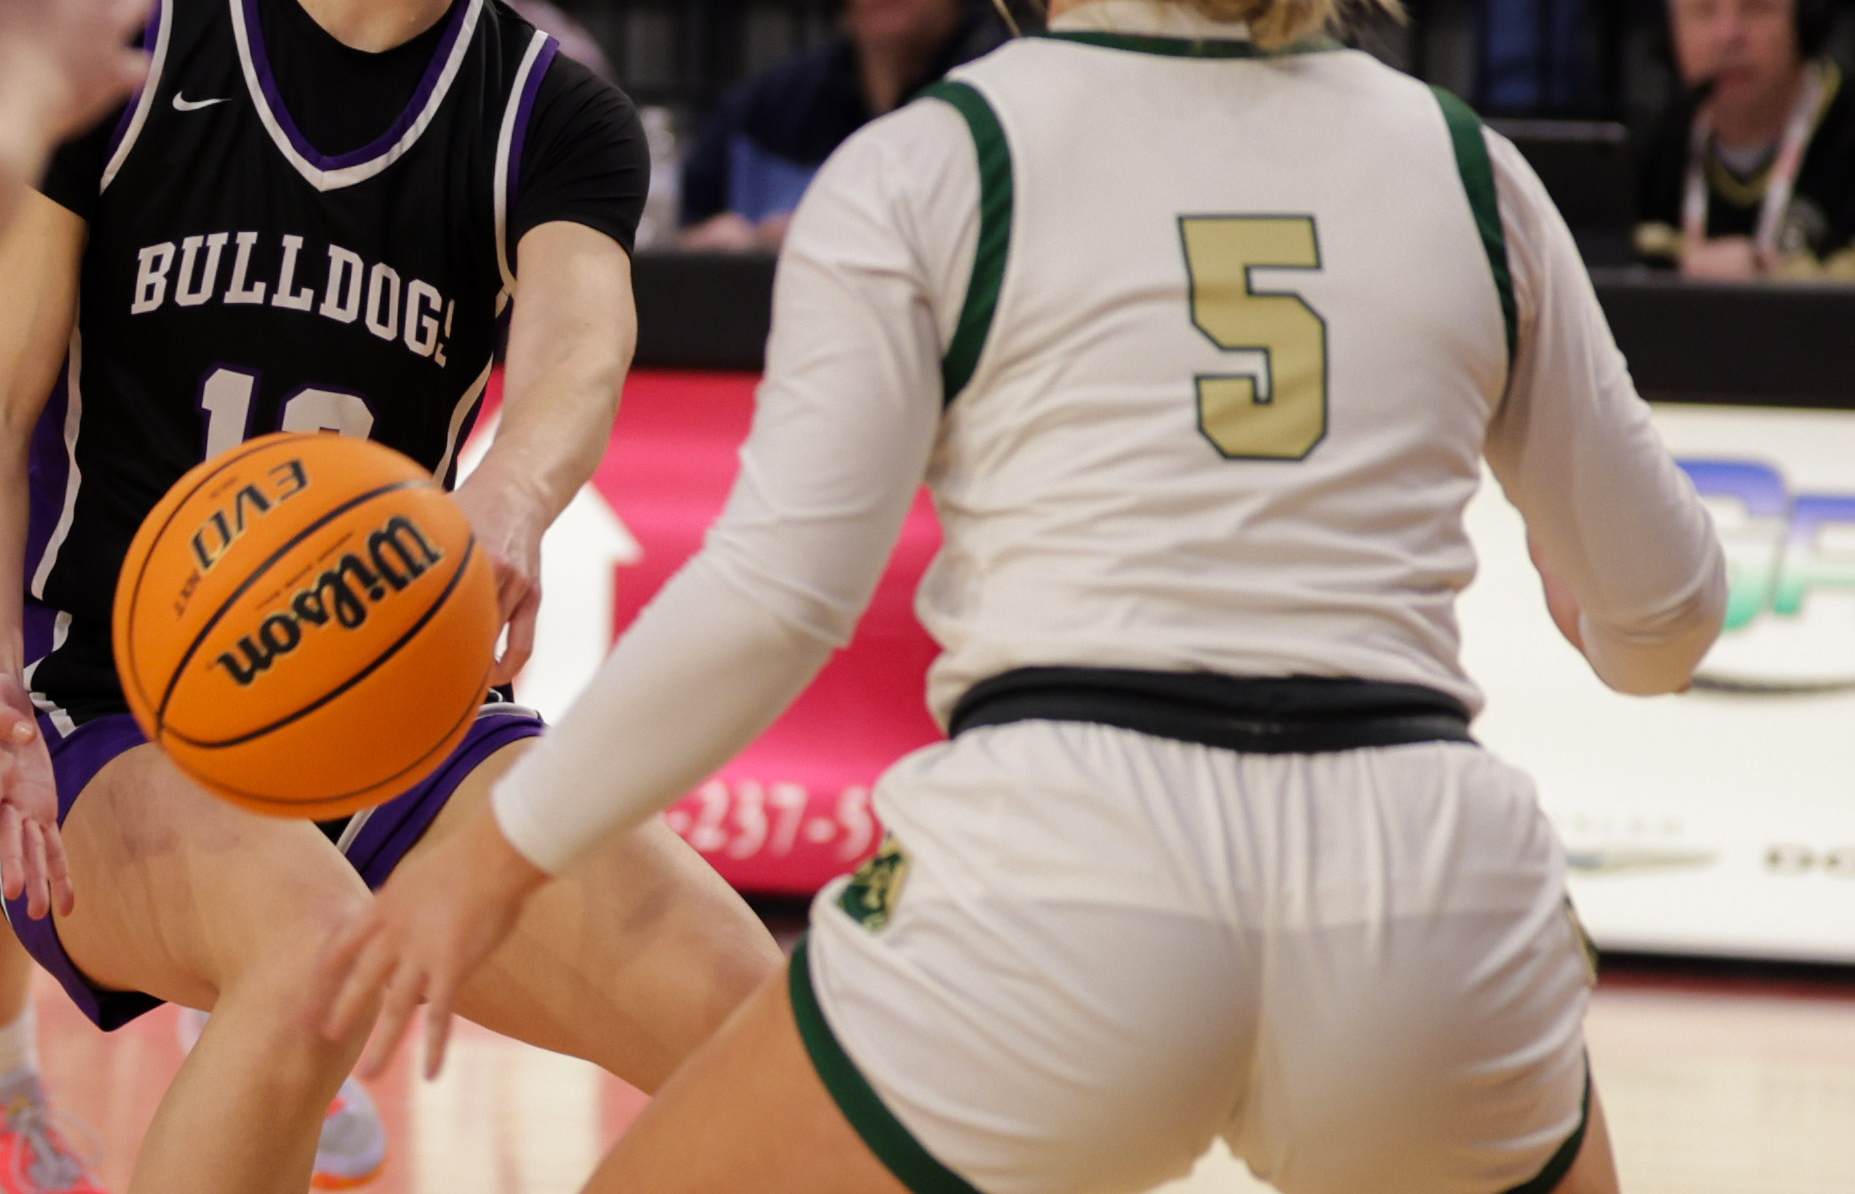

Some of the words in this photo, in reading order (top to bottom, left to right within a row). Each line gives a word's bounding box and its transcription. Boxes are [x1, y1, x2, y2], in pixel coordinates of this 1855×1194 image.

[1176, 213, 1329, 462] 5
[191, 458, 310, 572] EVO
[216, 512, 445, 687] Wilson
